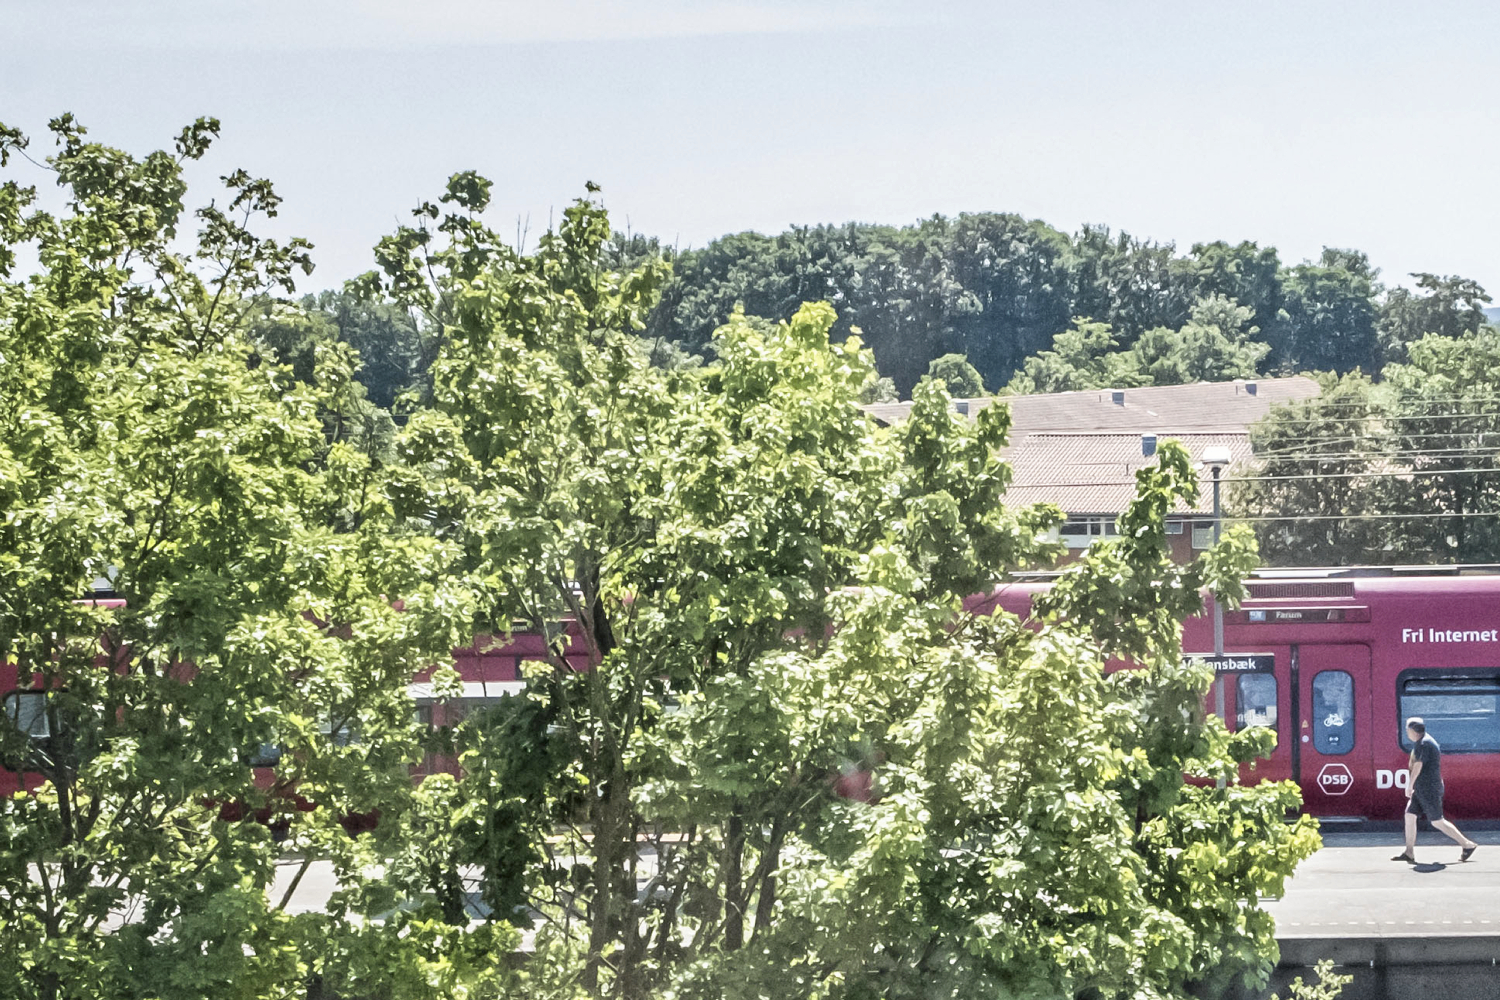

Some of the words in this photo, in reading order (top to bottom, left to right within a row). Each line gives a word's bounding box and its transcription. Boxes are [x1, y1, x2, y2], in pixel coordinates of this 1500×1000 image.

[1402, 628, 1424, 643] Fri
[1429, 628, 1498, 643] Internet
[1322, 774, 1349, 785] DSB
